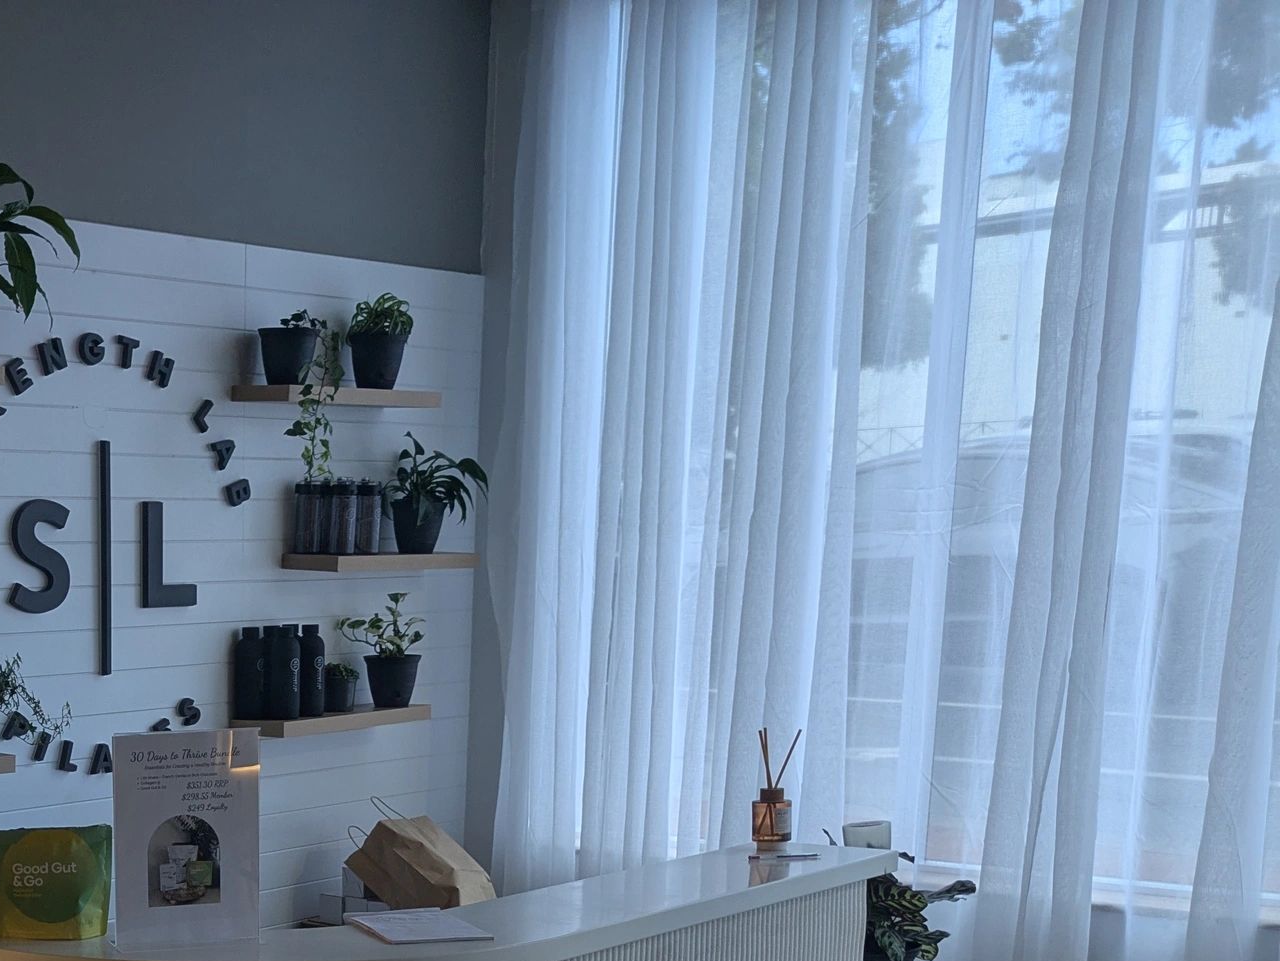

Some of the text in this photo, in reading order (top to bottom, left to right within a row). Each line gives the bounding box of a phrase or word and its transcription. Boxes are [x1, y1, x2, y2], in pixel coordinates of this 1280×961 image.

[192, 399, 252, 507] LAB
[0, 698, 201, 775] PILAS
[130, 751, 144, 763] 30
[147, 750, 168, 764] Days
[170, 751, 179, 760] to
[182, 748, 208, 760] Thrive
[214, 780, 229, 788] RRP
[12, 861, 77, 874] Good Gut
[13, 875, 43, 887] & Go
